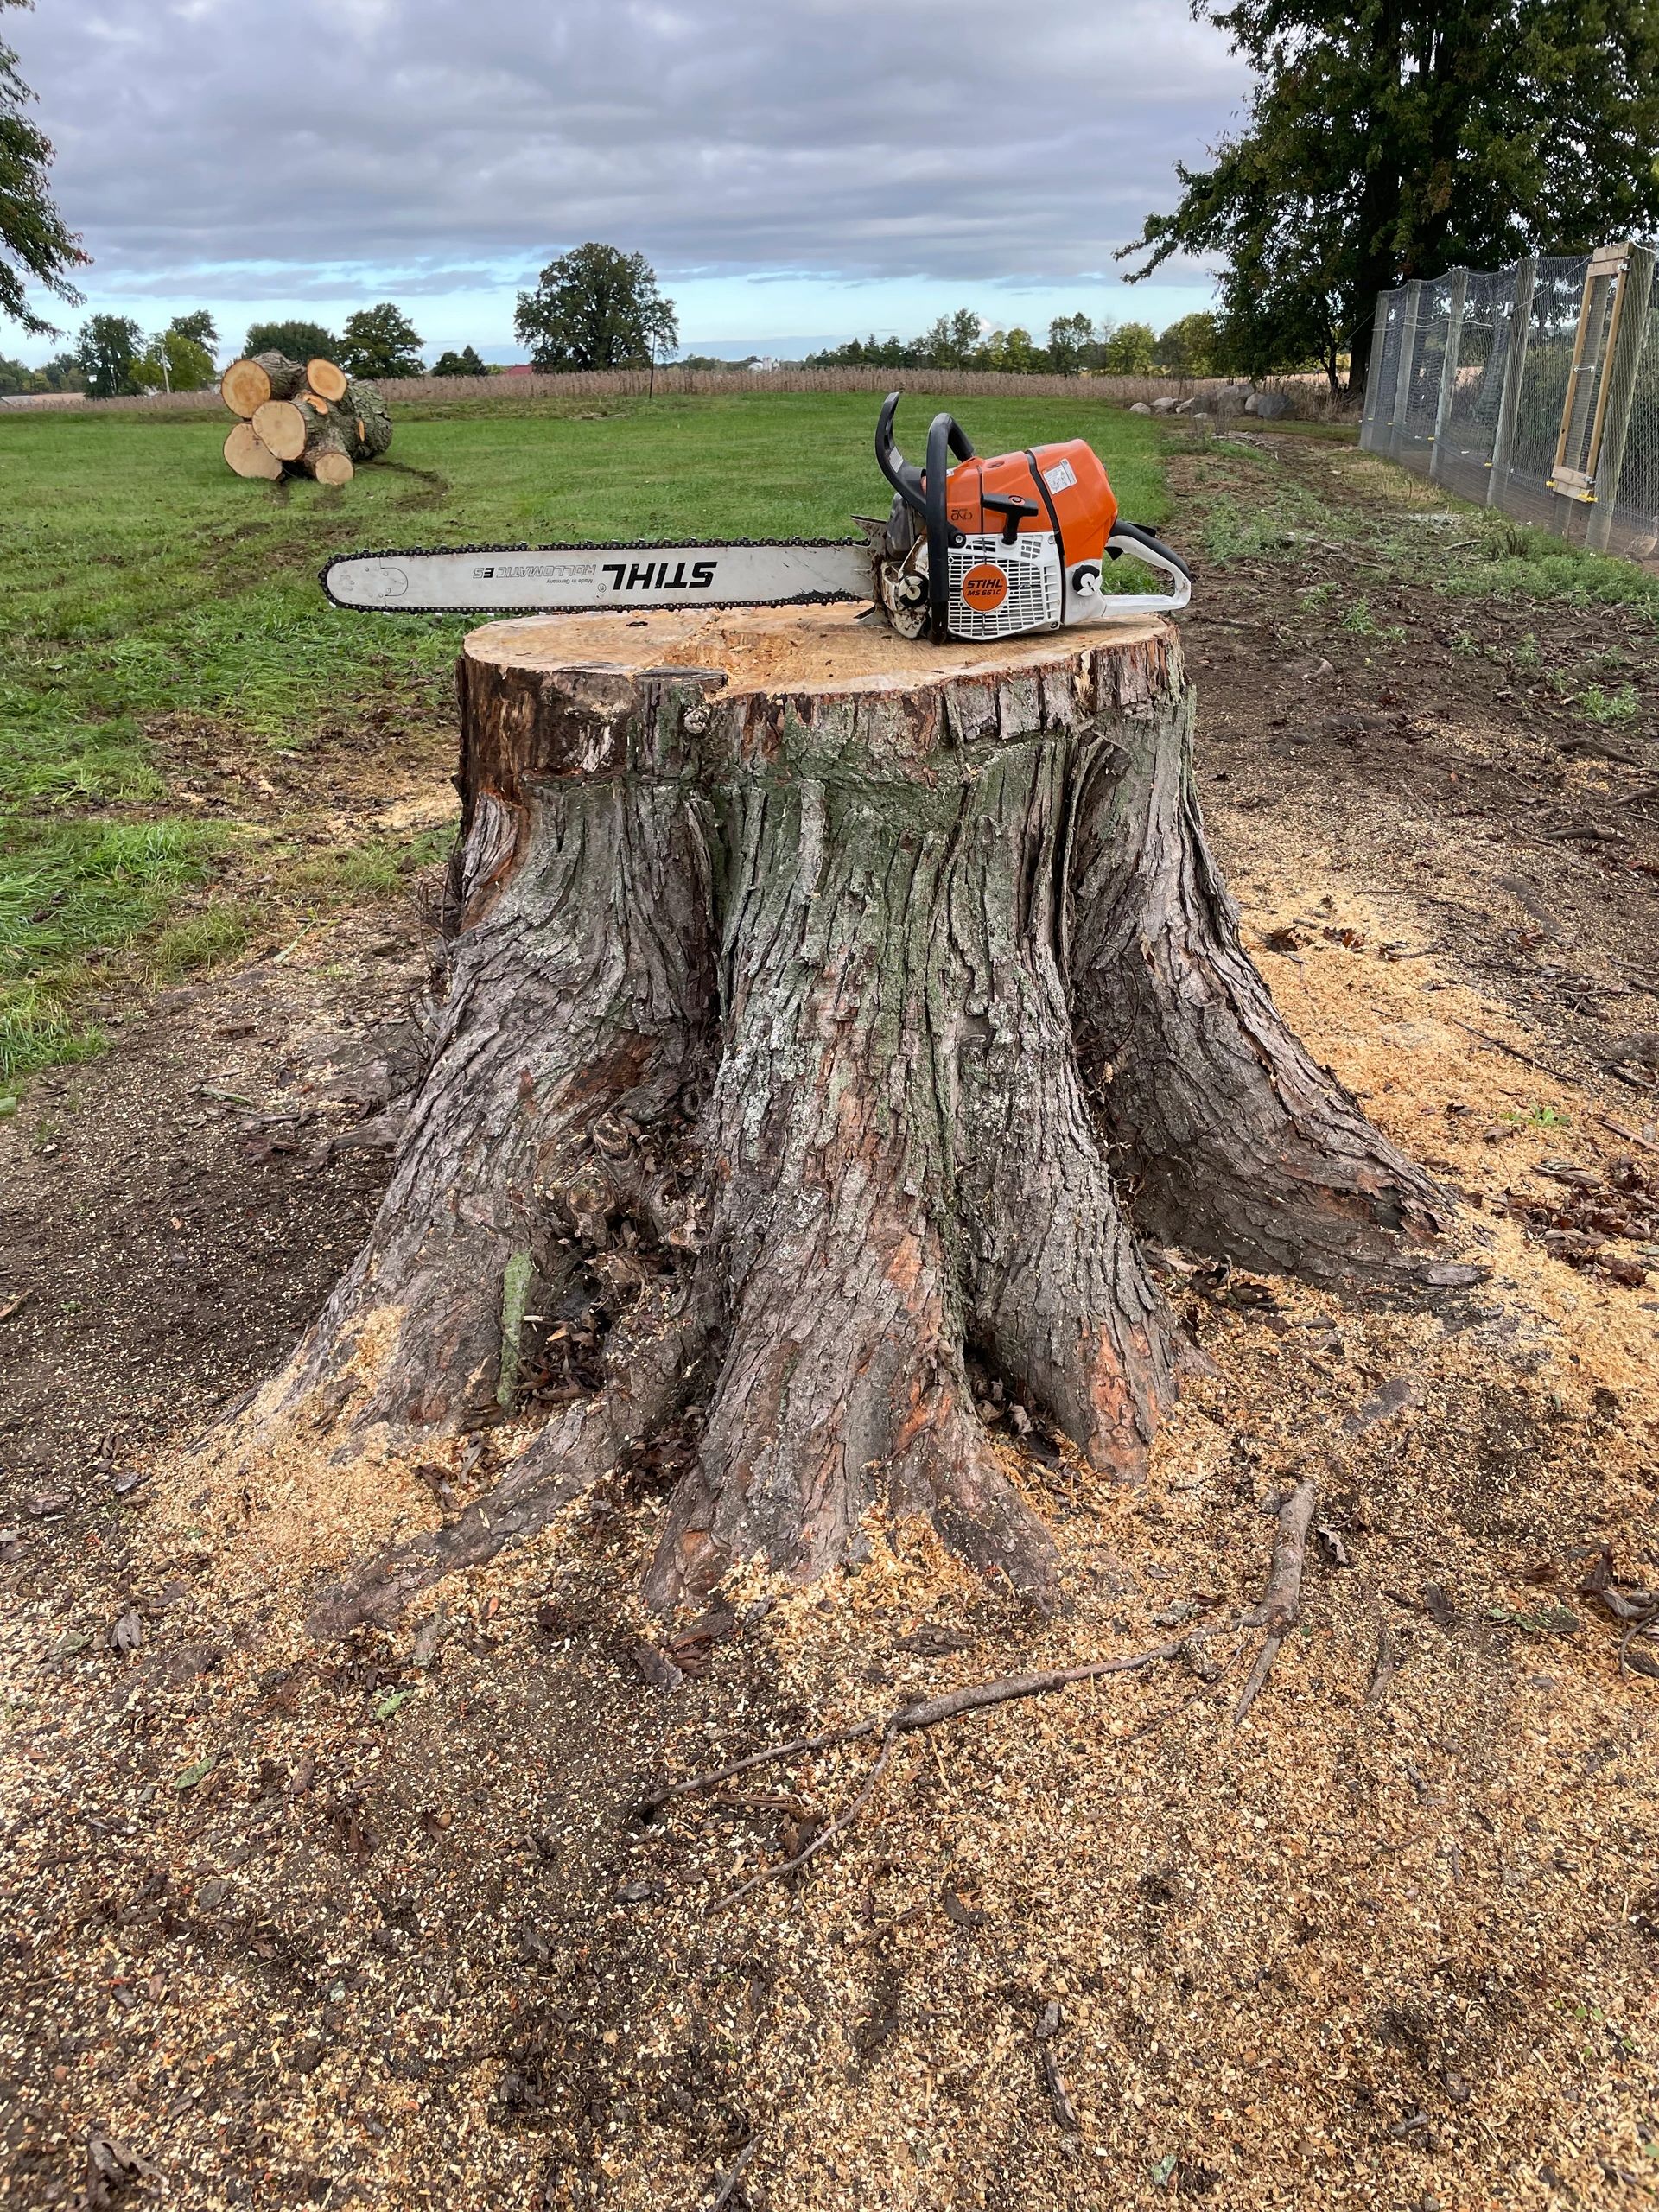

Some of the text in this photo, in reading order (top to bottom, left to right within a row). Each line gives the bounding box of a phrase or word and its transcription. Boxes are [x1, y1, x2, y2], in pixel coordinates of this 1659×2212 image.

[473, 564, 596, 578] ROLLOMATIC ES
[602, 561, 718, 590] STIHL
[966, 579, 1003, 588] STIHL
